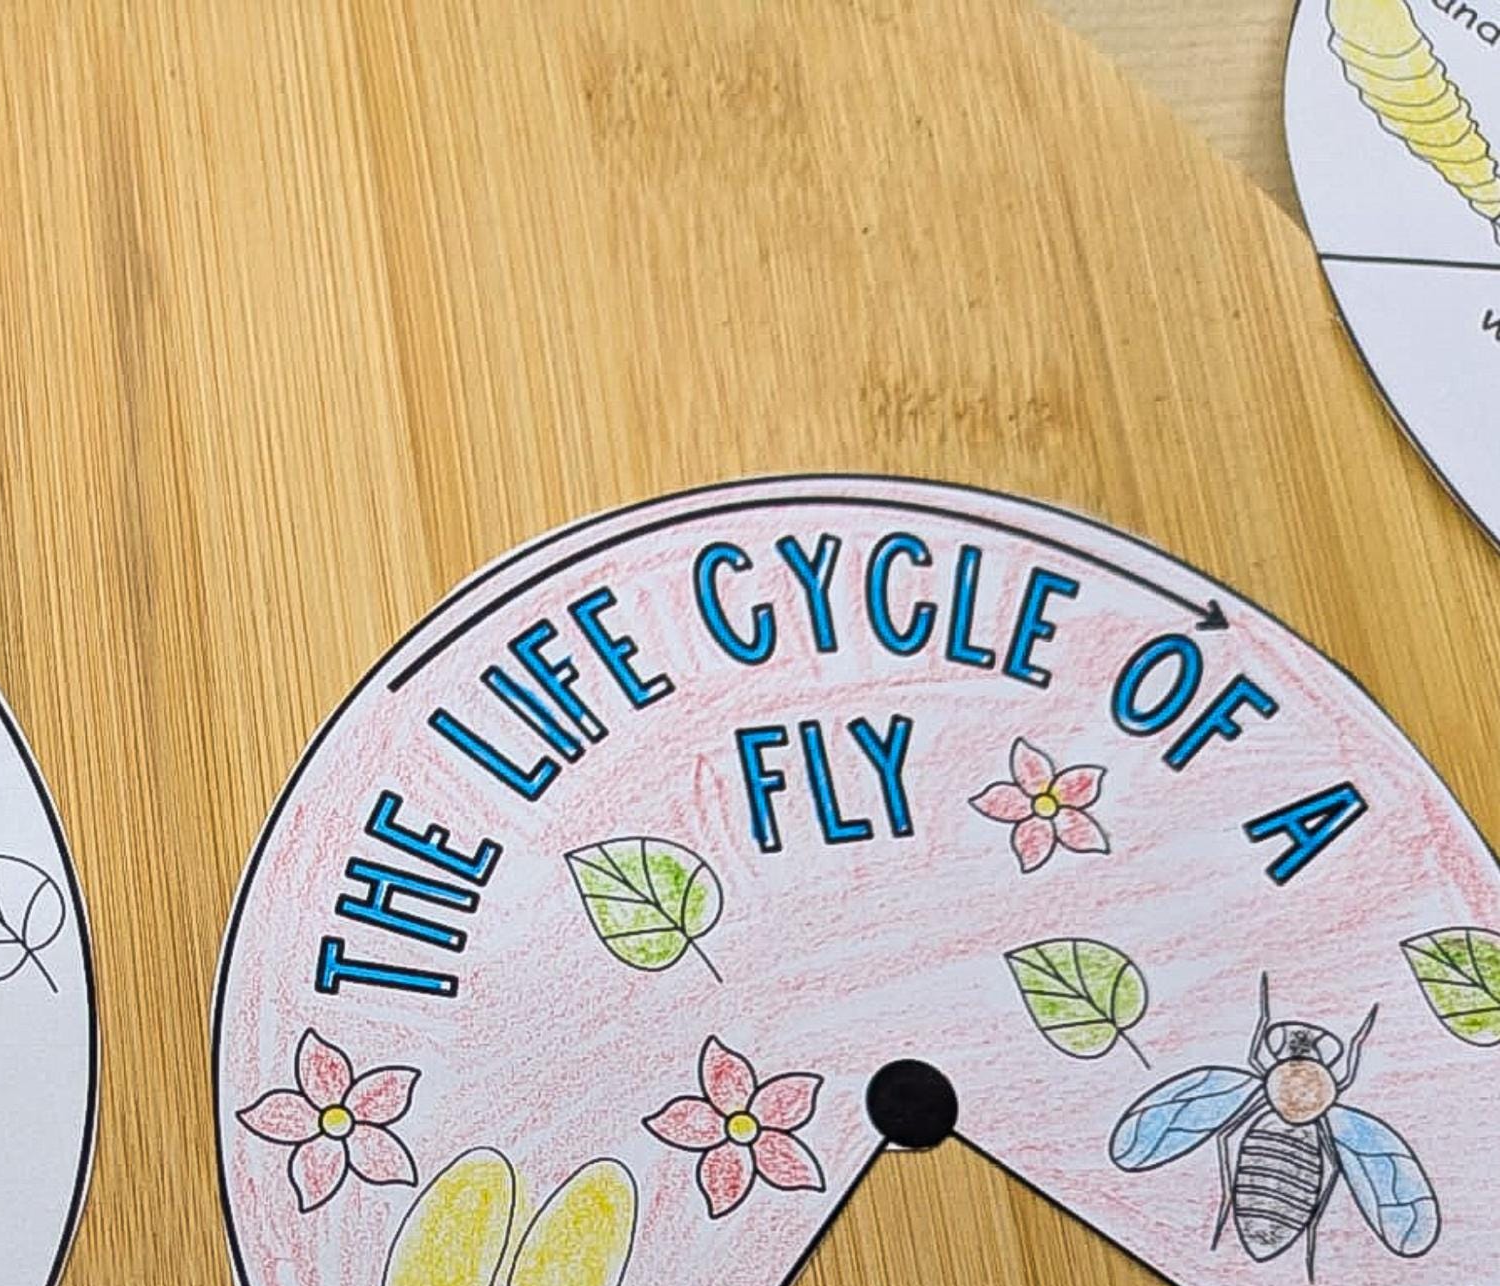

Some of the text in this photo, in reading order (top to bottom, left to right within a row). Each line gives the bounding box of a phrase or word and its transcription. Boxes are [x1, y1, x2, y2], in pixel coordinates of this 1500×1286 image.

[314, 531, 1370, 998] THE LIFE CYCLE OF A
[735, 714, 914, 853] FLY
